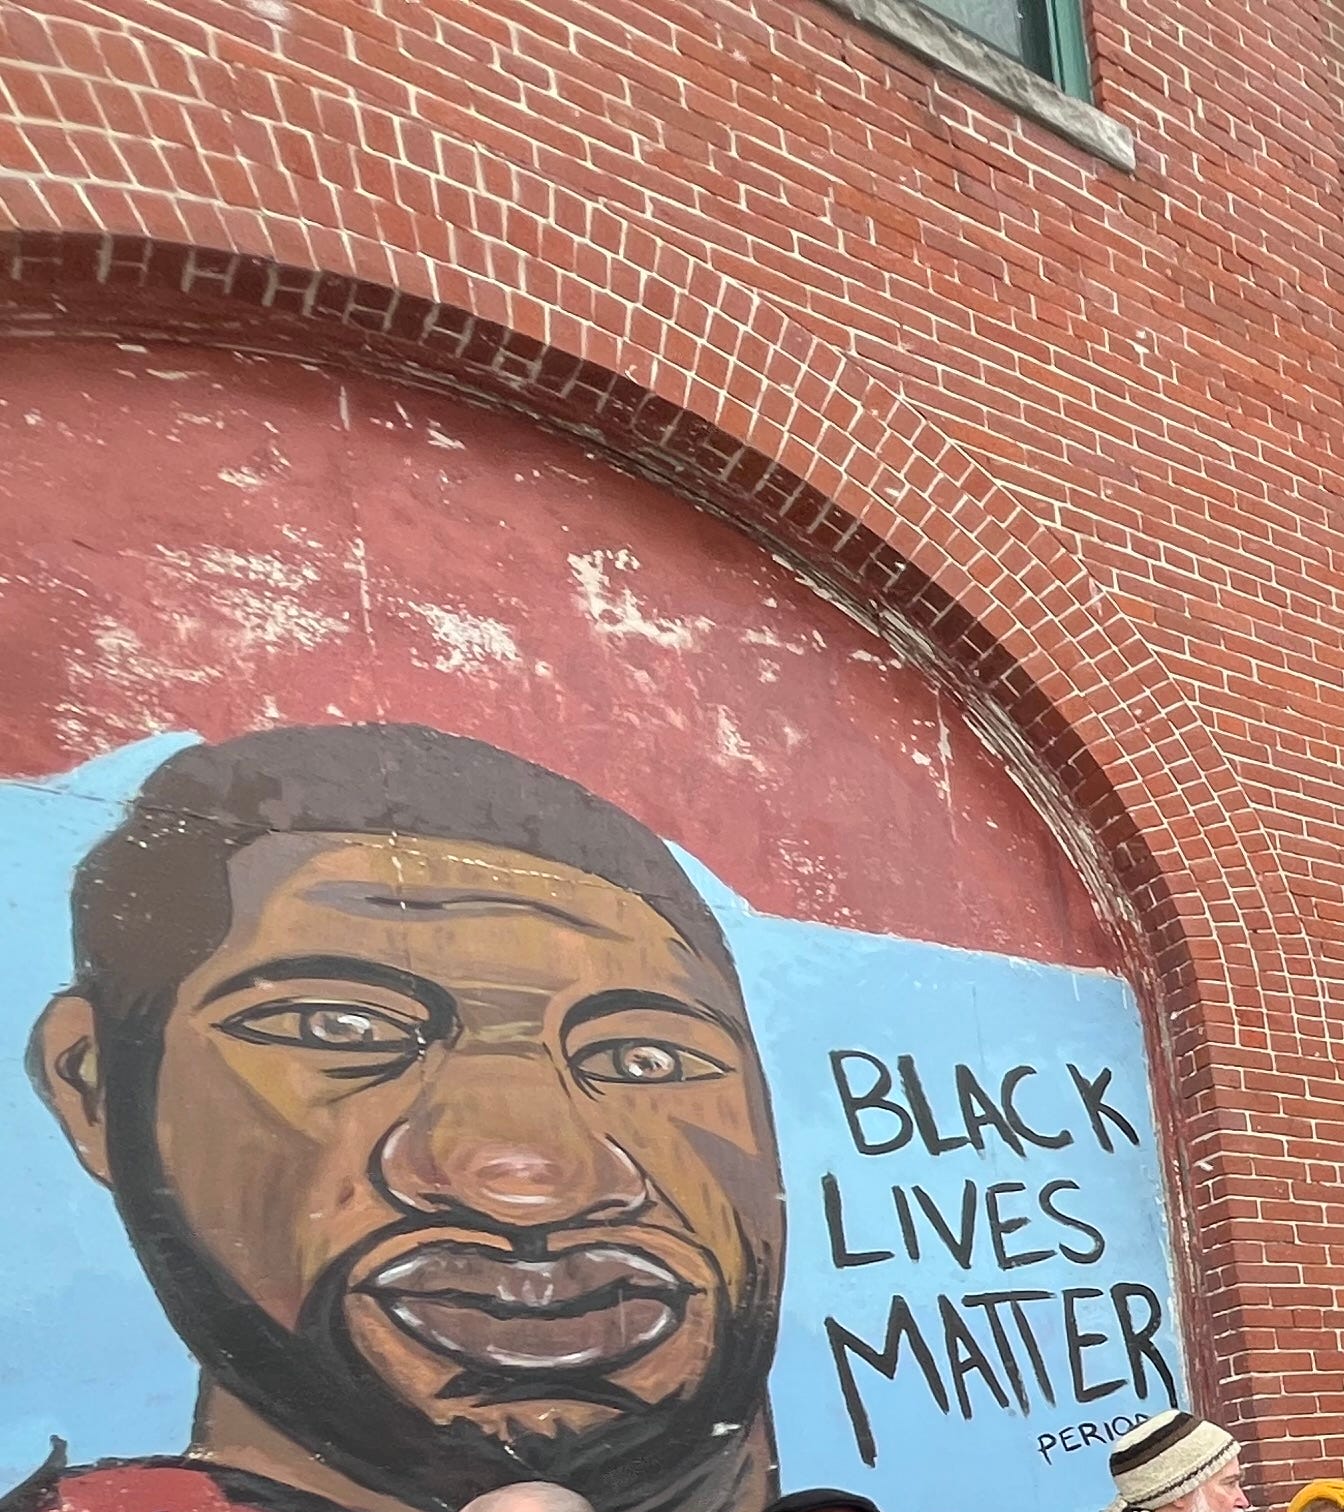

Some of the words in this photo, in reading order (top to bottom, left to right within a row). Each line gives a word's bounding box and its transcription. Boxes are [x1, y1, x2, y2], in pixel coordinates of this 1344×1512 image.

[829, 1049, 1140, 1157] BLACK
[821, 1171, 1106, 1271] LIVES
[824, 1283, 1177, 1468] MATTER
